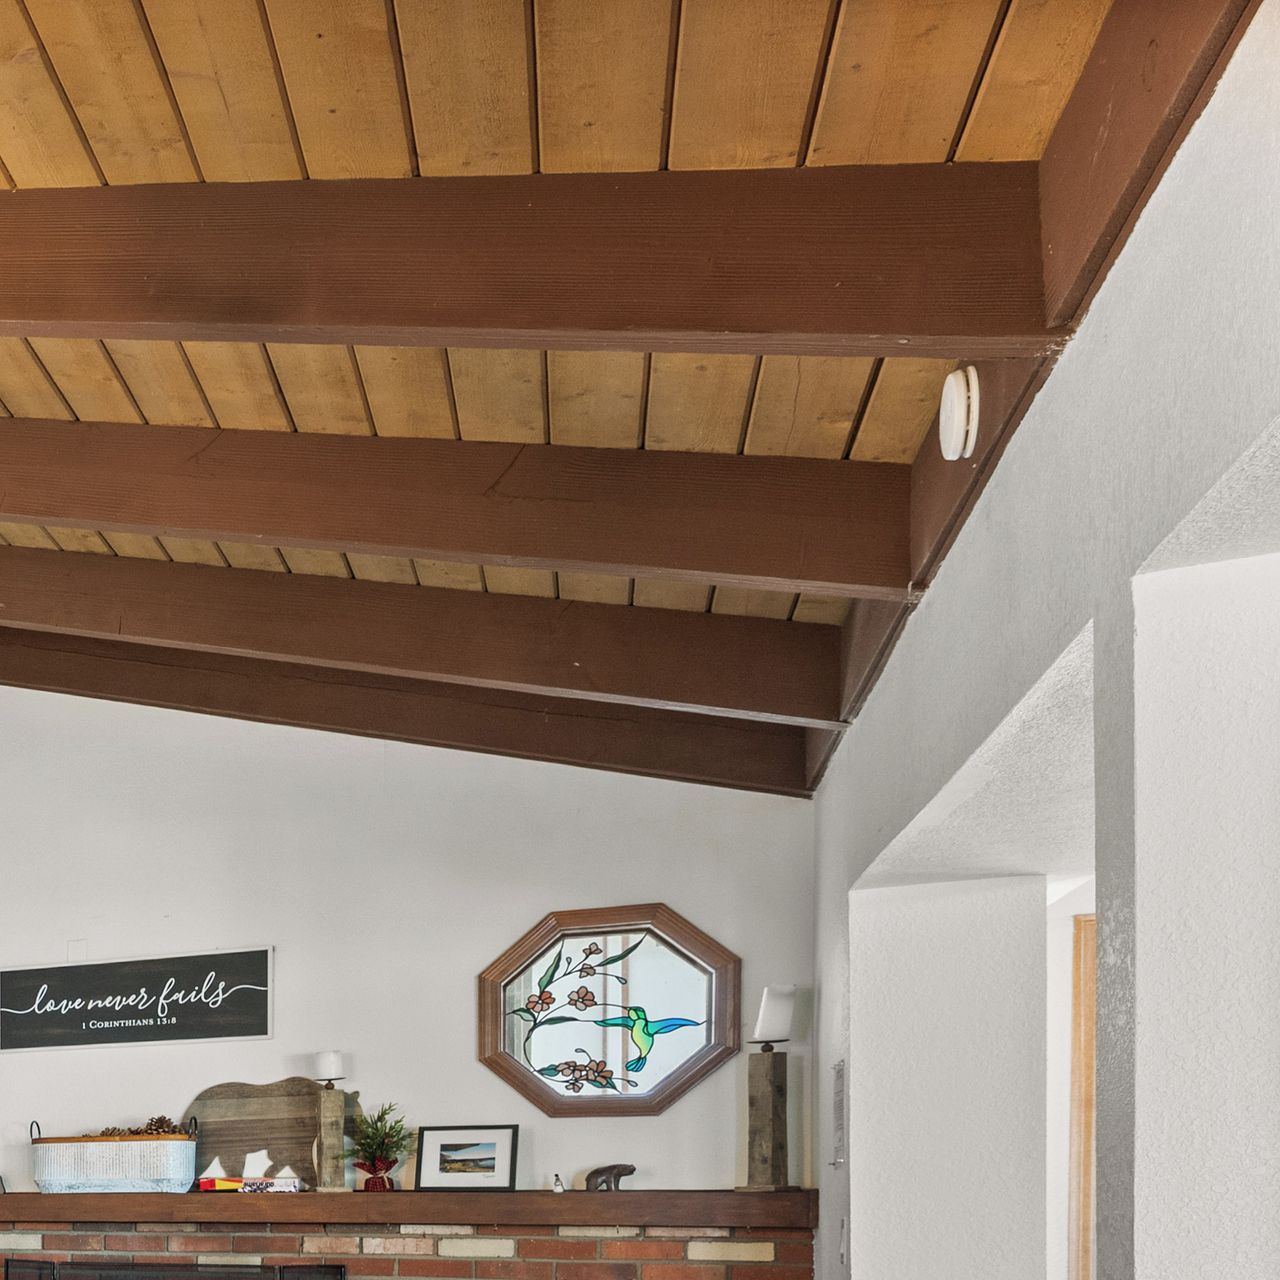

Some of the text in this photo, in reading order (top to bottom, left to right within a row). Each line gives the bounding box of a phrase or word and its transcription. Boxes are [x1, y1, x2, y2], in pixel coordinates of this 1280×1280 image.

[30, 971, 227, 1017] love never fails
[156, 1016, 177, 1025] 13:8
